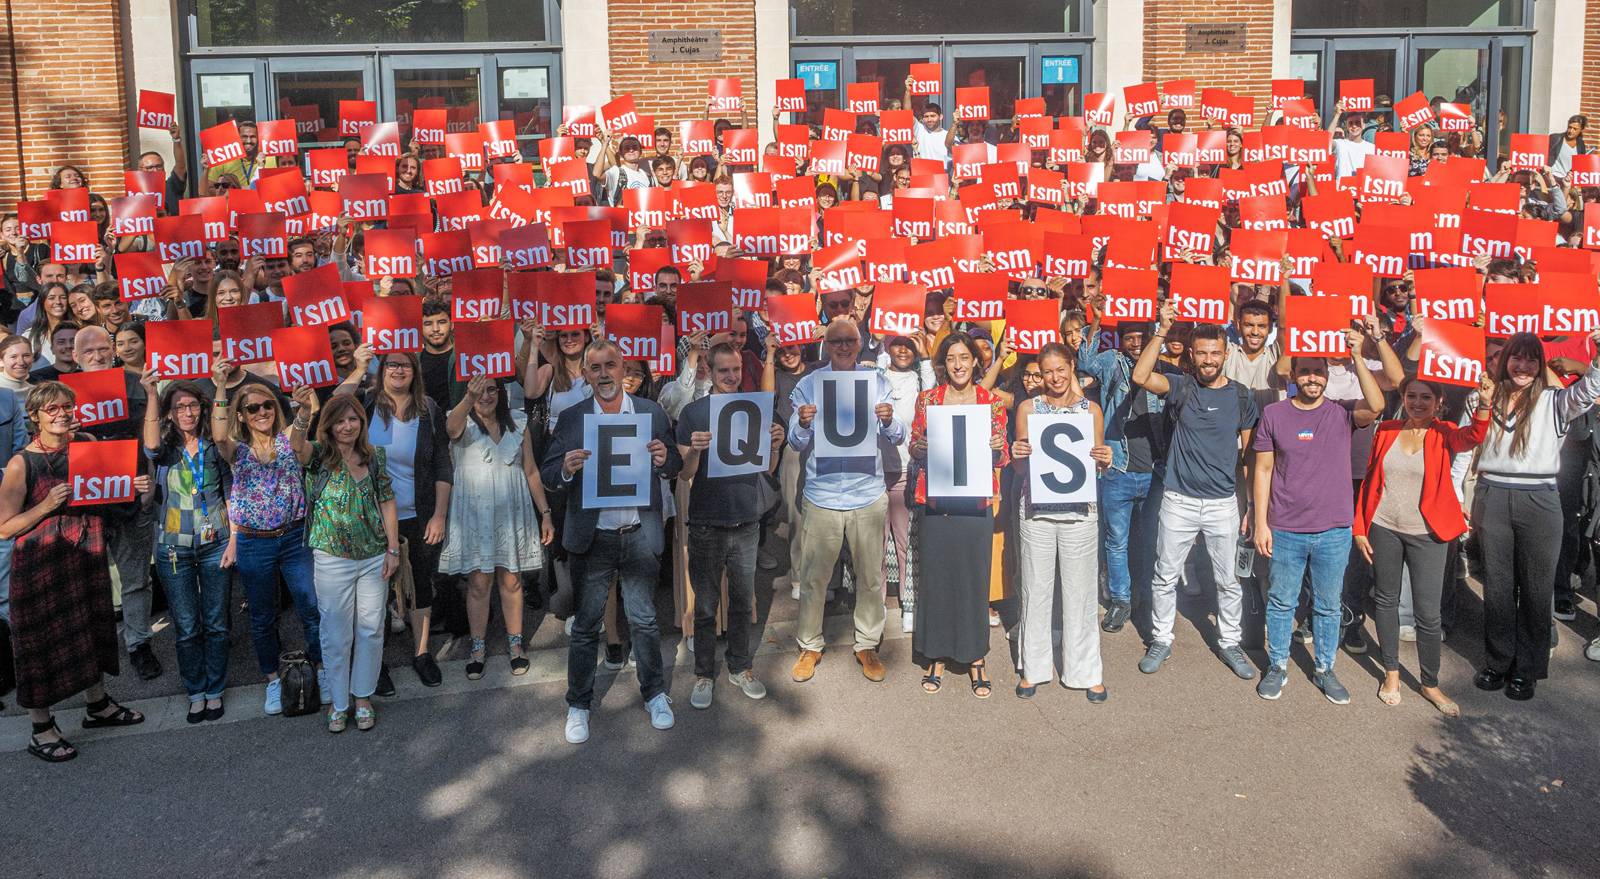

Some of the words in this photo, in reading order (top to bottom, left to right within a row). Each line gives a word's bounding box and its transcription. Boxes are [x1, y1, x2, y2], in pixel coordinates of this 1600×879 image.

[912, 80, 939, 93] tsm
[711, 95, 740, 110] tsm
[778, 96, 804, 110] tsm
[850, 99, 877, 113] tsm
[1129, 100, 1159, 115] tsm
[1165, 94, 1192, 106] tsm
[1342, 95, 1371, 109] tsm
[140, 109, 172, 128] tsm
[606, 111, 637, 130] tsm
[960, 104, 987, 118] tsm
[1084, 110, 1111, 125] tsm
[1202, 103, 1227, 120] tsm
[1225, 112, 1251, 125] sm
[566, 122, 593, 136] tsm
[1442, 117, 1469, 130] tsm
[415, 127, 444, 142] tsm
[883, 128, 912, 142] tsm
[1022, 134, 1049, 148] tsm
[207, 140, 243, 165] tsm
[262, 138, 296, 155] tsm
[484, 139, 515, 157] tsm
[683, 139, 713, 153] tsm
[725, 147, 755, 162] tsm
[780, 143, 807, 158] tsm
[1051, 147, 1081, 162] tsm
[1117, 147, 1148, 161] tsm
[1196, 148, 1224, 162] tsm
[1290, 146, 1326, 162] tsm
[812, 157, 843, 173] tsm
[848, 151, 878, 170] tsm
[1164, 150, 1193, 165] tsm
[1511, 150, 1544, 167] tsm
[429, 177, 461, 194] tsm
[1364, 175, 1404, 196] tsm
[1572, 170, 1600, 185] tsm
[993, 182, 1017, 197] sm
[1030, 183, 1061, 202] tsm
[1250, 179, 1286, 197] tsm
[60, 209, 87, 222] sm
[343, 199, 386, 218] tsm
[536, 209, 550, 226] ts
[1100, 202, 1134, 218] tsm
[115, 216, 154, 234] tsm
[628, 210, 662, 228] tsm
[895, 218, 930, 237] tsm
[242, 236, 284, 257] tsm
[736, 234, 777, 254] tsm
[780, 235, 808, 252] sm
[1169, 225, 1210, 252] tsm
[1462, 233, 1511, 257] tsm
[55, 243, 98, 261] tsm
[160, 239, 203, 261] tsm
[473, 244, 501, 263] sm
[568, 246, 609, 266] tsm
[672, 242, 709, 264] tsm
[987, 248, 1031, 270] tsm
[369, 255, 412, 275] tsm
[429, 254, 472, 277] tsm
[869, 262, 907, 282] tsm
[1045, 254, 1087, 275] tsm
[1230, 255, 1280, 281] tsm
[122, 275, 165, 298] tsm
[633, 271, 656, 289] ts
[910, 266, 955, 288] tsm
[293, 296, 346, 326] tsm
[456, 297, 500, 319] tsm
[513, 299, 537, 320] ts
[542, 303, 592, 326] tsm
[957, 298, 1003, 318] tsm
[1105, 295, 1152, 317] tsm
[1173, 293, 1224, 320] tsm
[1421, 298, 1474, 320] tsm
[681, 310, 728, 332] tsm
[874, 308, 920, 331] tsm
[1490, 311, 1539, 335] tsm
[1544, 305, 1600, 332] tsm
[367, 327, 418, 350] tsm
[774, 319, 816, 343] tsm
[1007, 327, 1055, 349] tsm
[1290, 327, 1345, 353] tsm
[152, 352, 208, 377] tsm
[280, 359, 333, 387] tsm
[460, 351, 510, 376] tsm
[1423, 349, 1481, 382] tsm
[597, 424, 637, 497] E
[717, 399, 763, 466] Q
[823, 380, 868, 447] U
[952, 415, 967, 486] I
[1040, 422, 1086, 494] S
[74, 475, 131, 500] tsm
